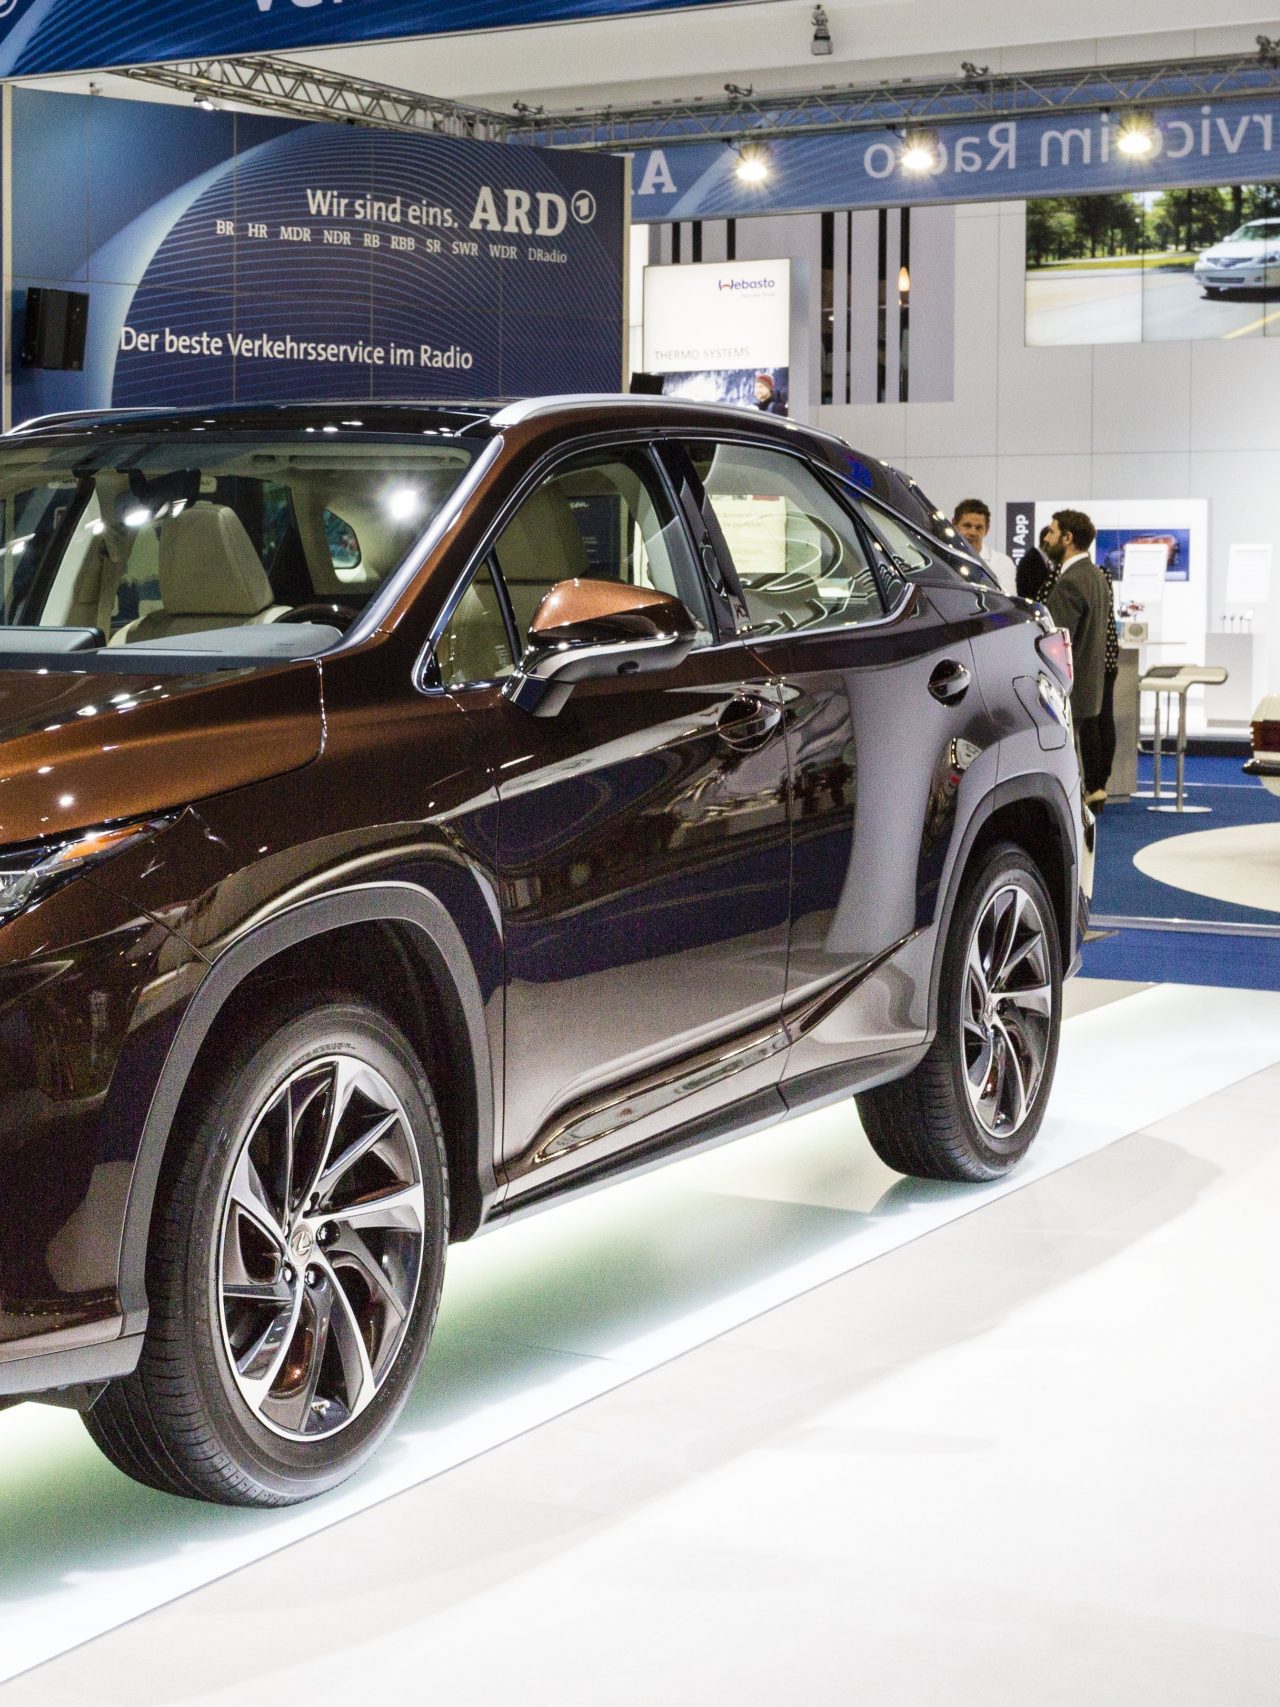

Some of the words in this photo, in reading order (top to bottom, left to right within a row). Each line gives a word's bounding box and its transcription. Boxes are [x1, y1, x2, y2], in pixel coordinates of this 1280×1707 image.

[306, 189, 349, 218] Wir
[354, 194, 401, 223] sind
[407, 199, 459, 228] eins.
[469, 186, 568, 237] ARD
[216, 219, 235, 236] BR
[248, 223, 268, 238] HR
[280, 226, 311, 242] MDR
[323, 229, 351, 246] NDR
[364, 233, 380, 248] RB
[391, 235, 415, 251] RBB
[426, 239, 441, 253] SR
[452, 240, 479, 257] SWR
[489, 244, 518, 260] WDR
[528, 247, 568, 264] DRadio
[718, 278, 775, 290] Webasto
[121, 326, 160, 352] Der
[165, 327, 222, 356] beste
[227, 333, 385, 365] Verkehrsservice
[390, 342, 414, 366] im
[421, 344, 473, 369] Radio
[654, 349, 700, 361] THERMO
[703, 346, 751, 359] SYSTEMS
[1013, 514, 1029, 546] App
